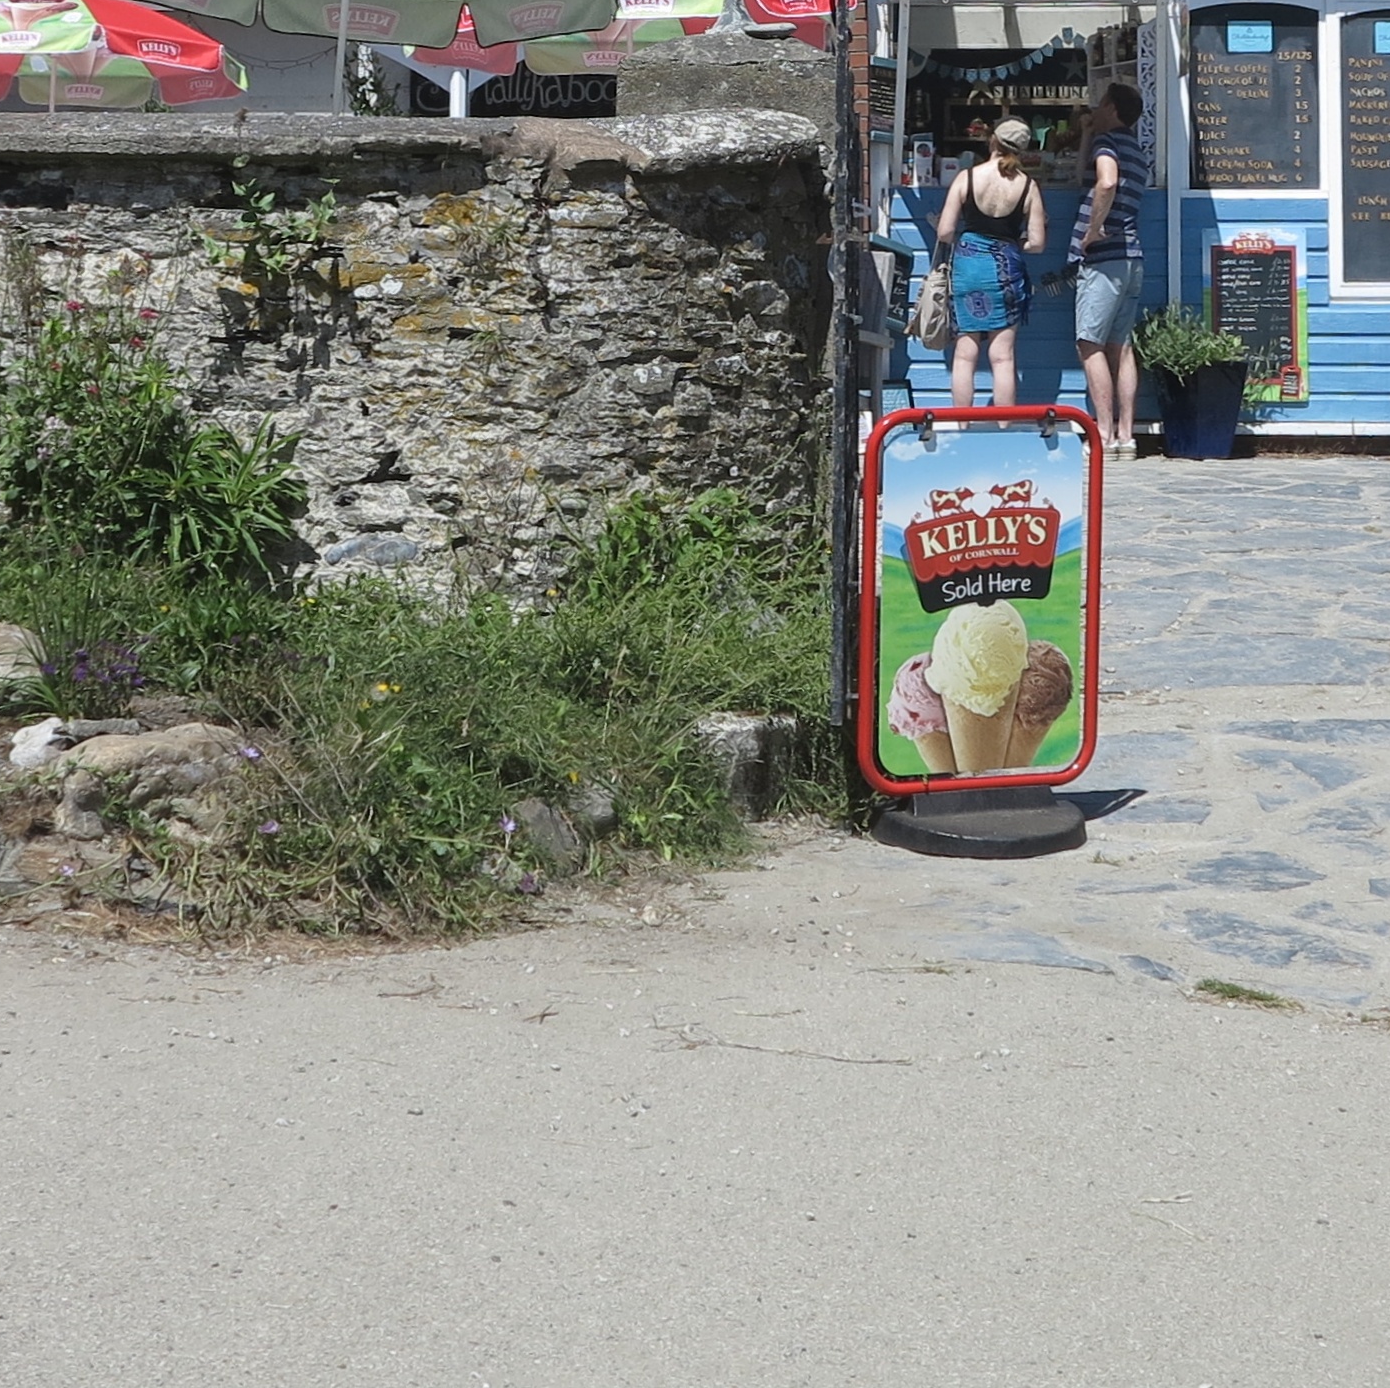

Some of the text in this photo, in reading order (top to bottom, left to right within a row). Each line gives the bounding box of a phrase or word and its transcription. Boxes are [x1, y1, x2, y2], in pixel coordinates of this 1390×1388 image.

[1, 32, 38, 43] KELLY'S
[141, 42, 178, 56] KELLY'S
[1197, 53, 1214, 62] TEA
[1349, 57, 1383, 68] PANINI
[1197, 64, 1302, 74] FILTER COFFEE 2
[1294, 76, 1302, 85] 2
[1349, 72, 1374, 82] SOUP
[1377, 72, 1388, 81] OF
[1236, 89, 1302, 99] DELUXE 3
[1350, 87, 1386, 97] NACHOS
[1197, 102, 1221, 112] CANS
[1197, 116, 1228, 125] WATER
[1350, 115, 1380, 125] BAKED
[1199, 130, 1301, 140] JUICE 2
[1293, 145, 1301, 153] 4
[1350, 145, 1378, 155] PASTY
[1248, 159, 1274, 170] SODA
[1293, 158, 1301, 167] 4
[1351, 159, 1390, 169] SAUSAGE
[1269, 174, 1288, 183] MUG
[1295, 173, 1302, 181] 6
[1358, 195, 1387, 205] LUNCH
[1352, 212, 1370, 220] SEE
[1234, 240, 1272, 249] KELLY'S
[917, 512, 1047, 560] KELLY'S
[949, 547, 1020, 564] OF CORNWALL
[941, 572, 1032, 603] Sold Here
